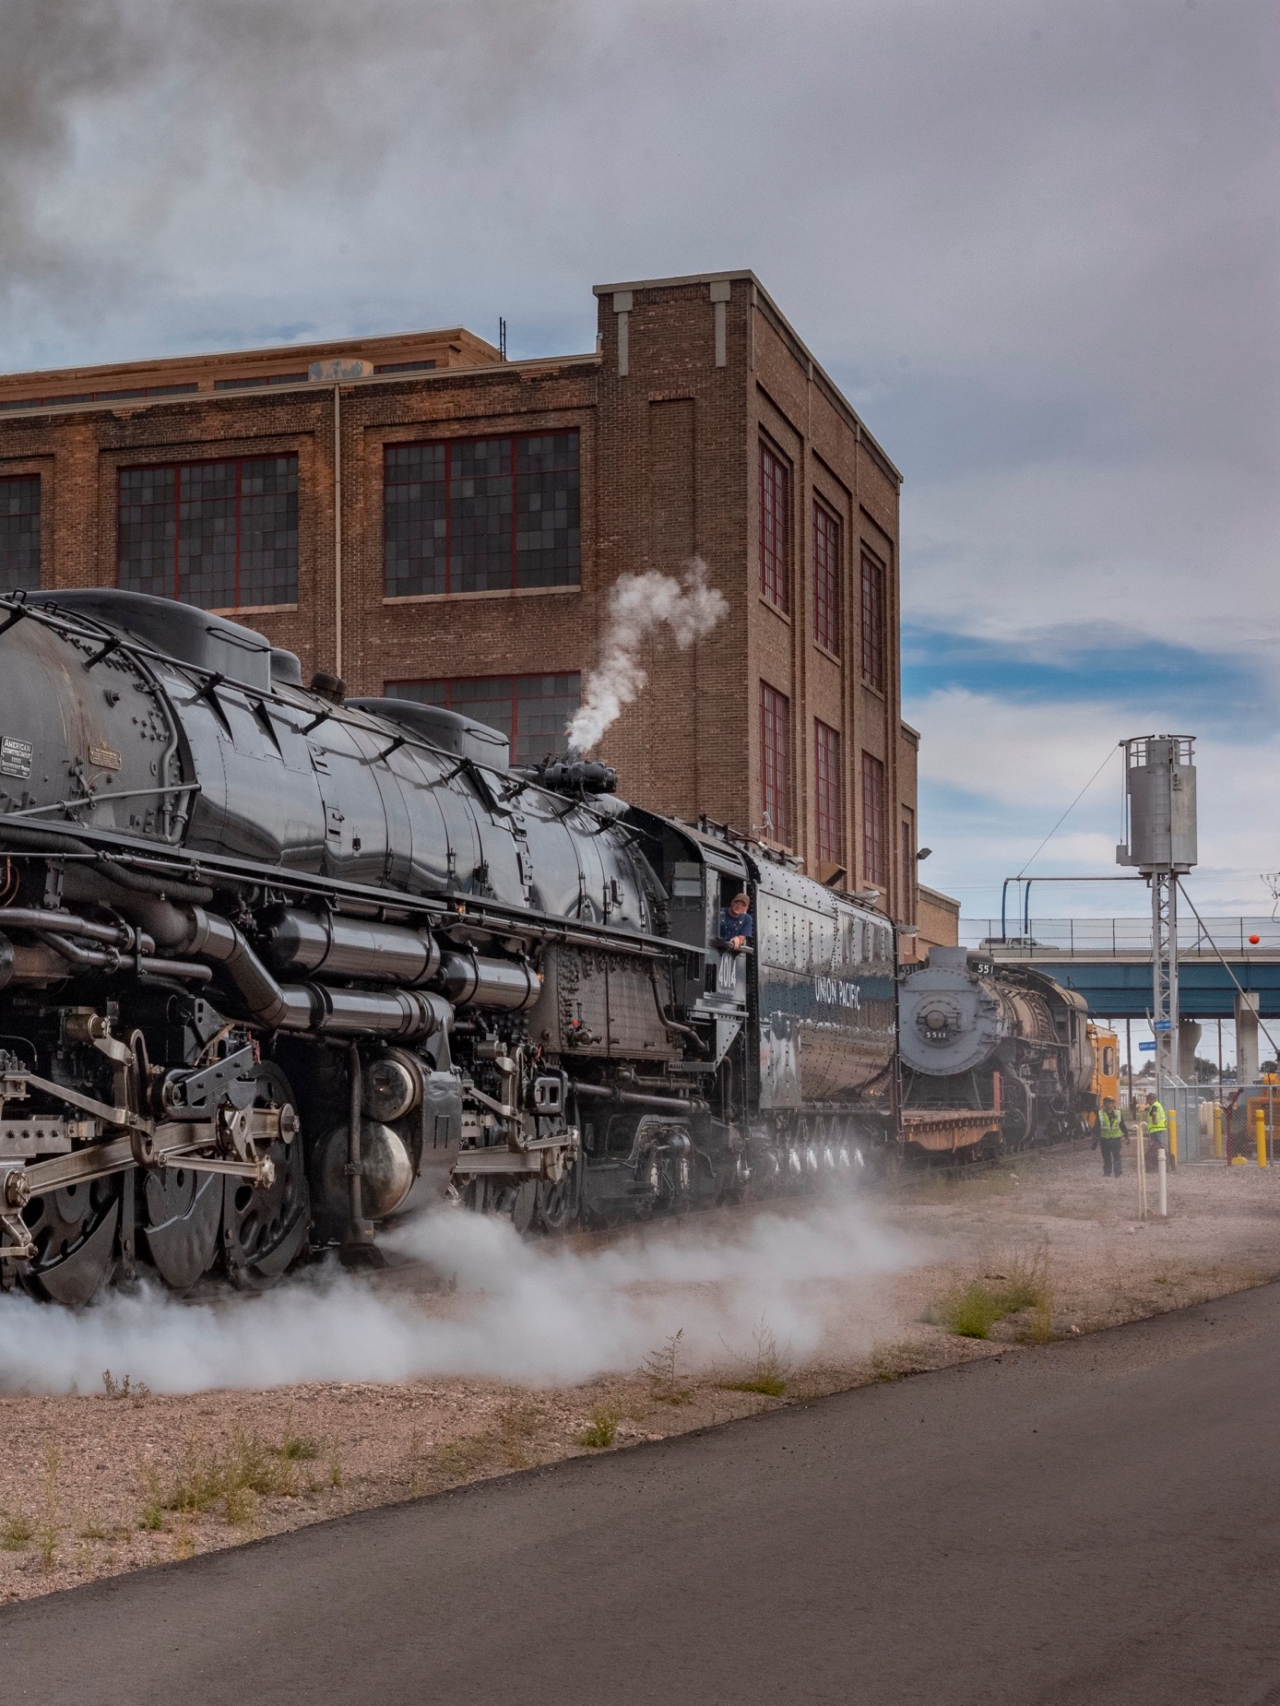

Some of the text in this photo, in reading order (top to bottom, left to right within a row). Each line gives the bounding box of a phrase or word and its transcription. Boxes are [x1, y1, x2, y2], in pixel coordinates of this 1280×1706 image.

[719, 955, 736, 988] 4014
[815, 974, 861, 1010] UNION PACIFIC
